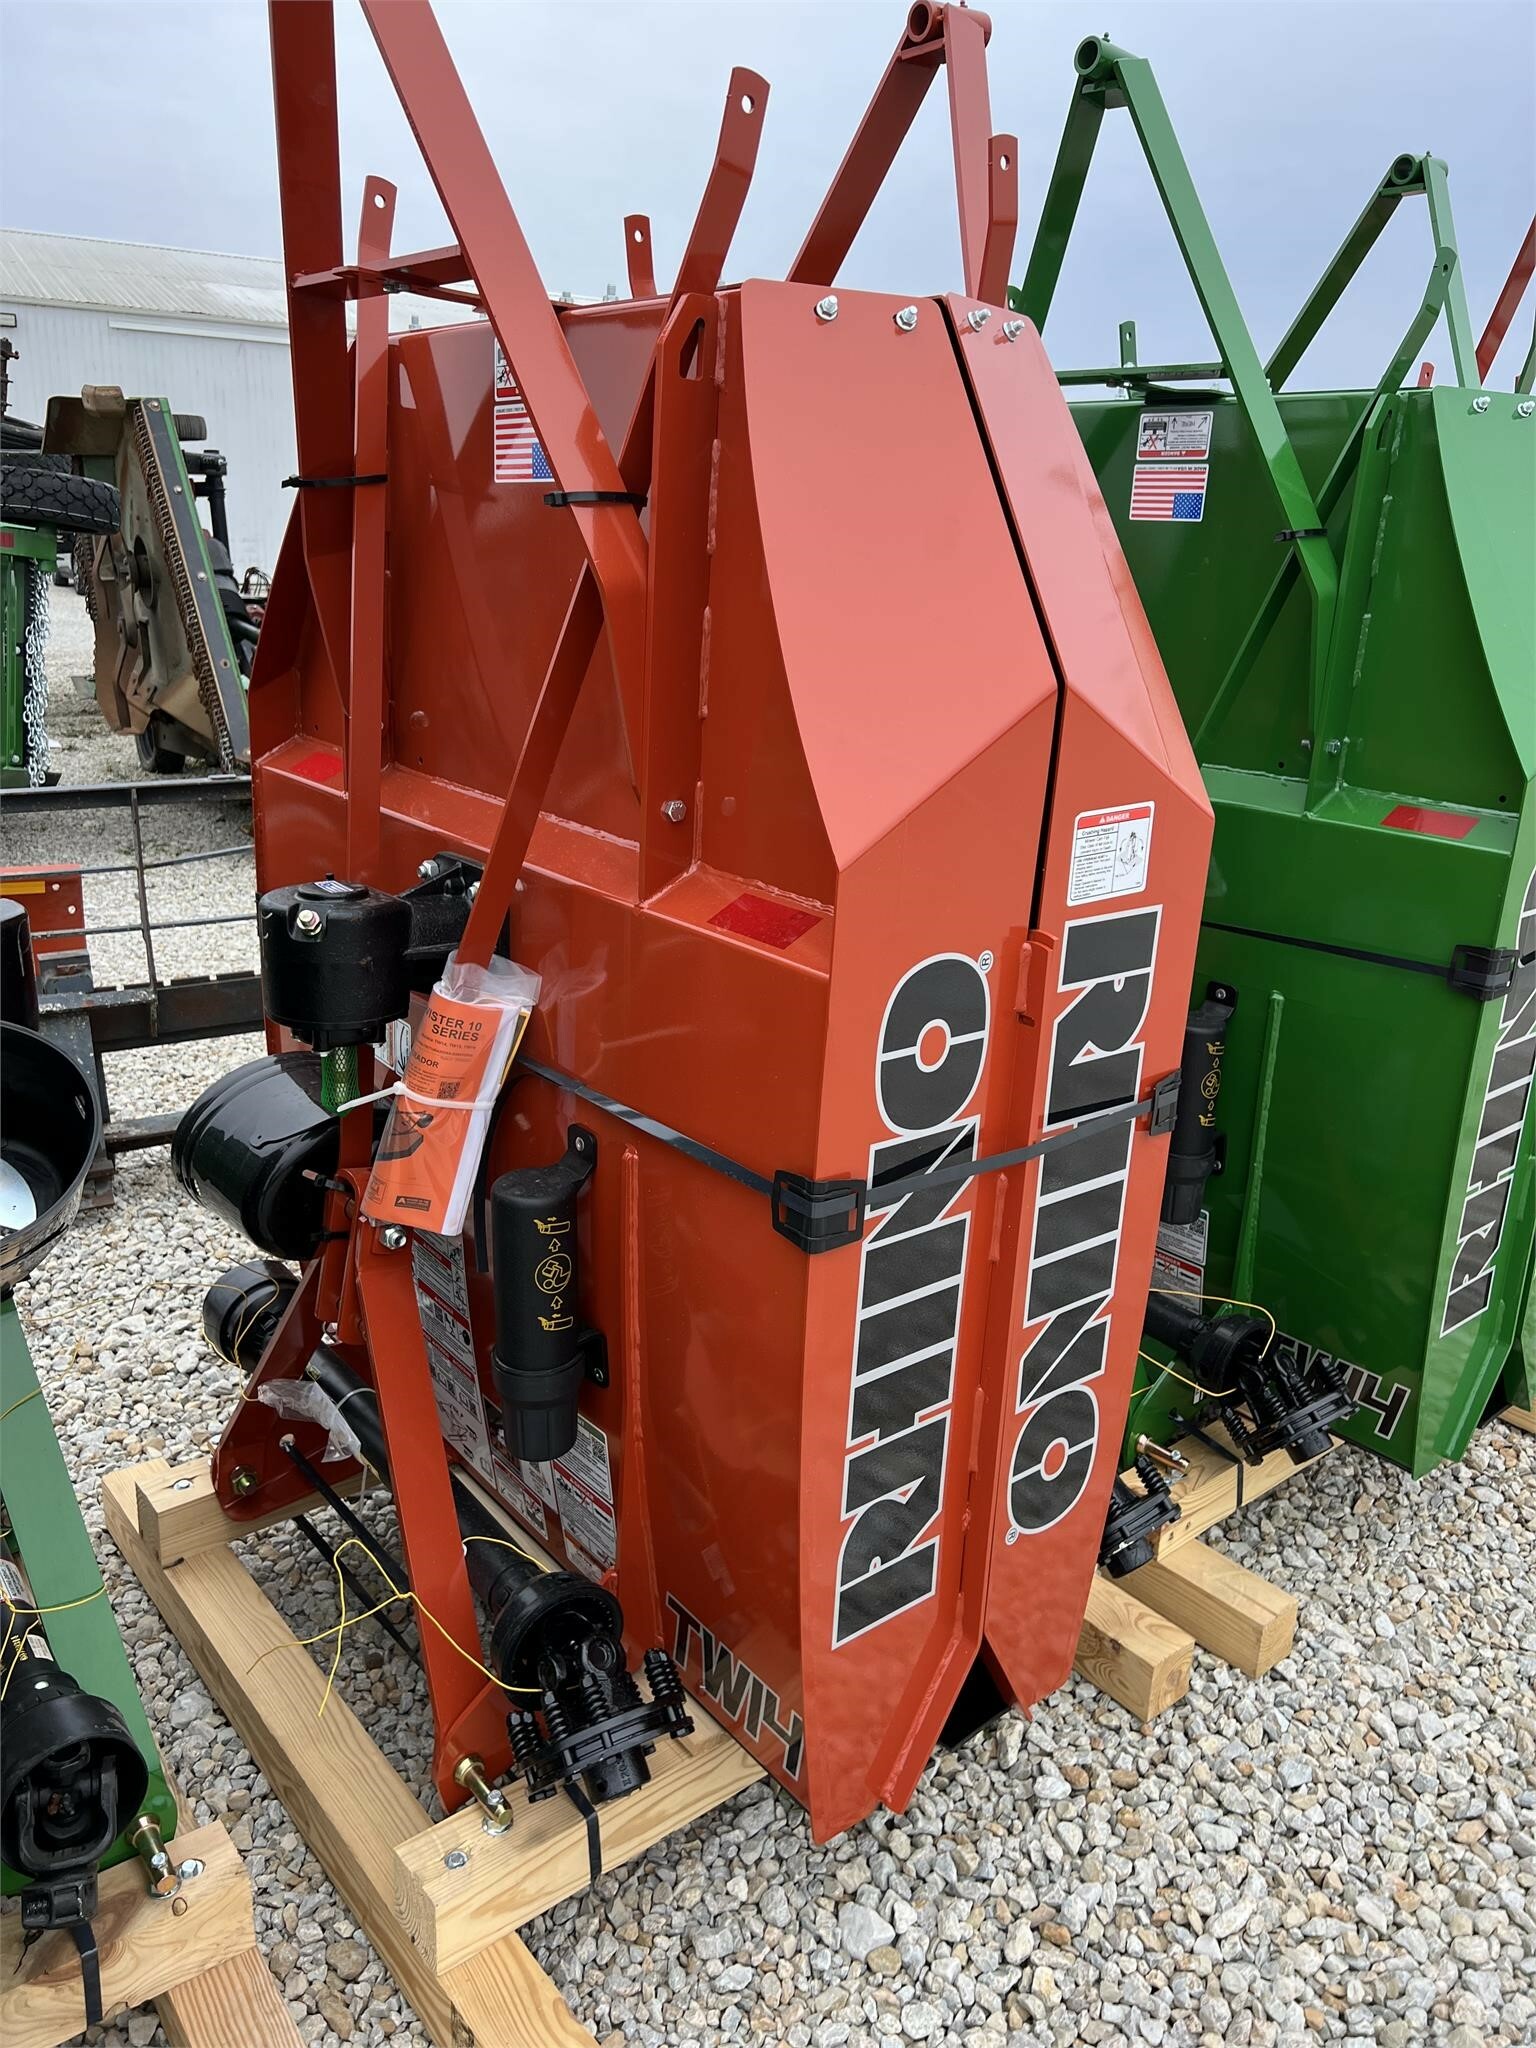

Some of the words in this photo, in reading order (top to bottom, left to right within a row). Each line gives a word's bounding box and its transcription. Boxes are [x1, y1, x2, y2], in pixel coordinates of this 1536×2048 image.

[1106, 812, 1130, 823] DANGER
[469, 1021, 483, 1032] 10
[431, 1023, 480, 1042] SERIES
